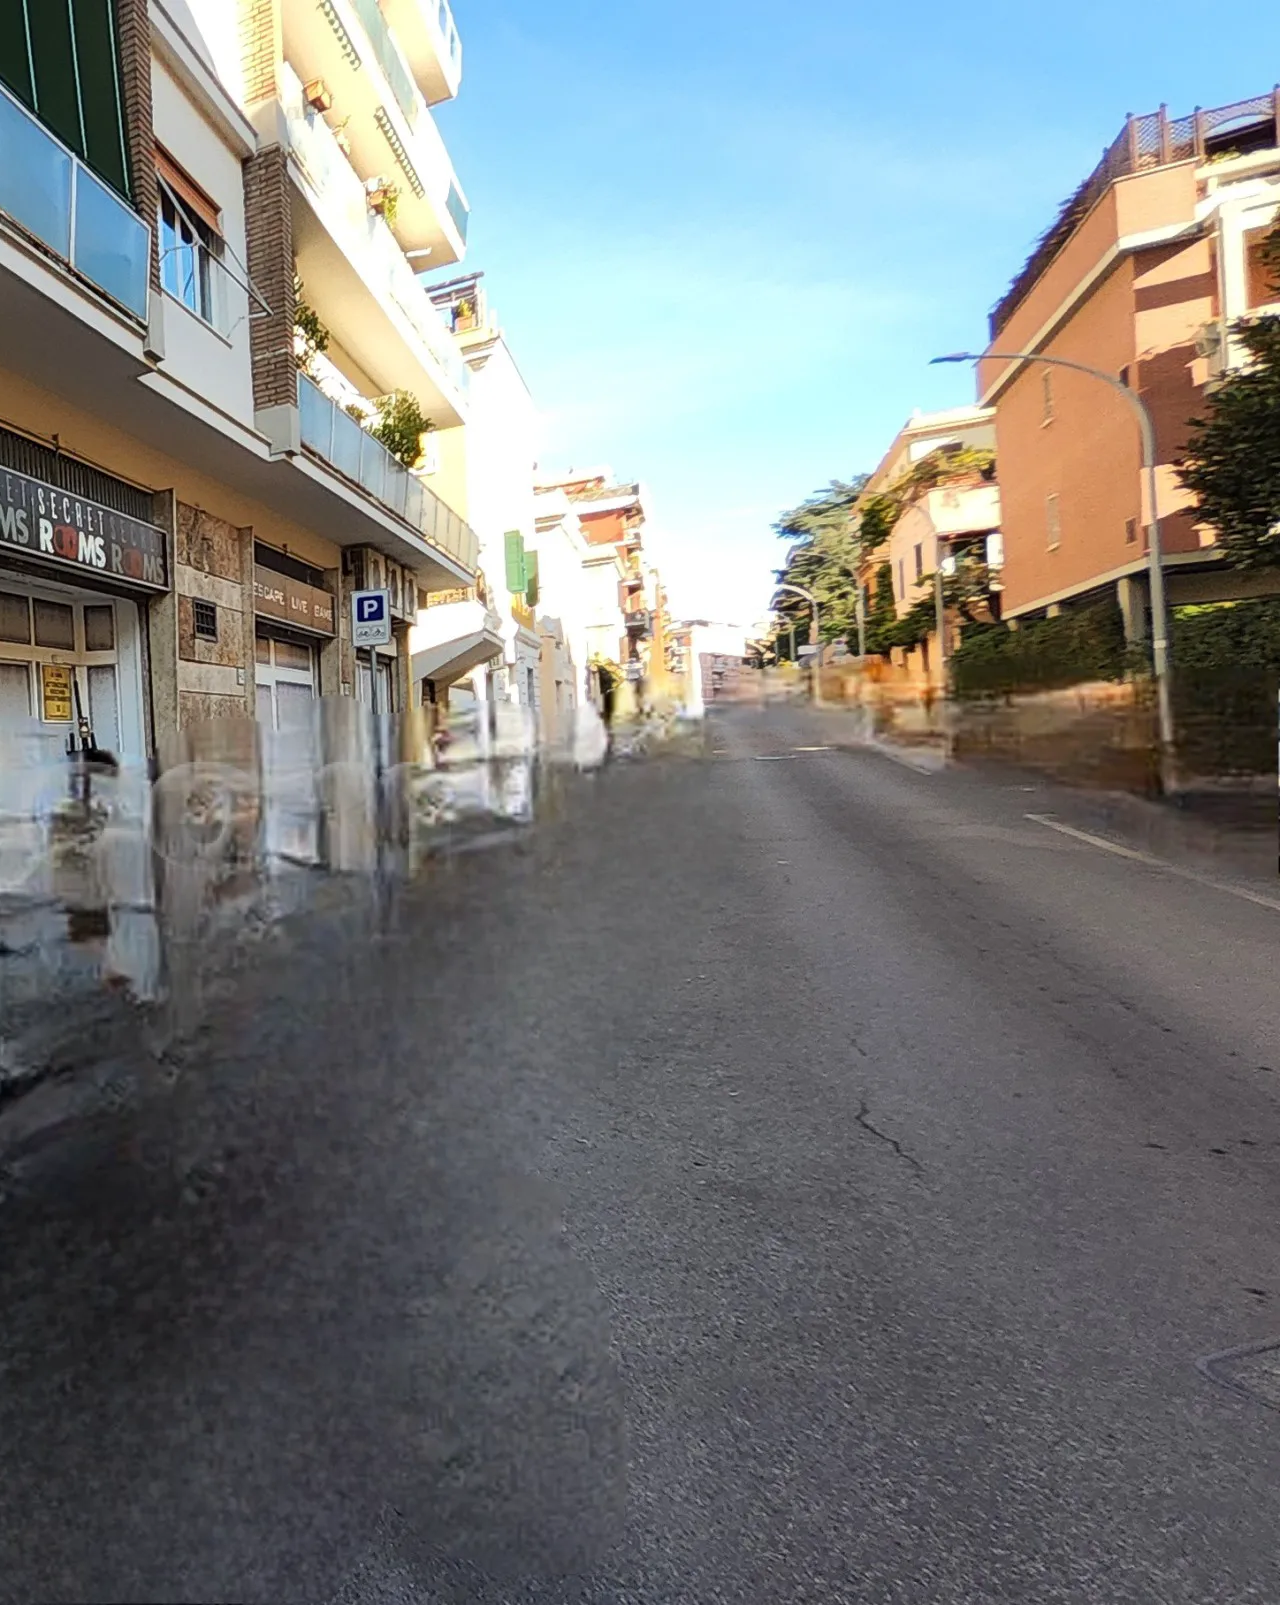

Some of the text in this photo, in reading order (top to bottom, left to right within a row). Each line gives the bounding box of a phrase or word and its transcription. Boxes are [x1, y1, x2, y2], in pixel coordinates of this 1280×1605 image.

[38, 518, 106, 568] ROOMS
[291, 596, 308, 614] LIVE
[363, 599, 378, 619] P
